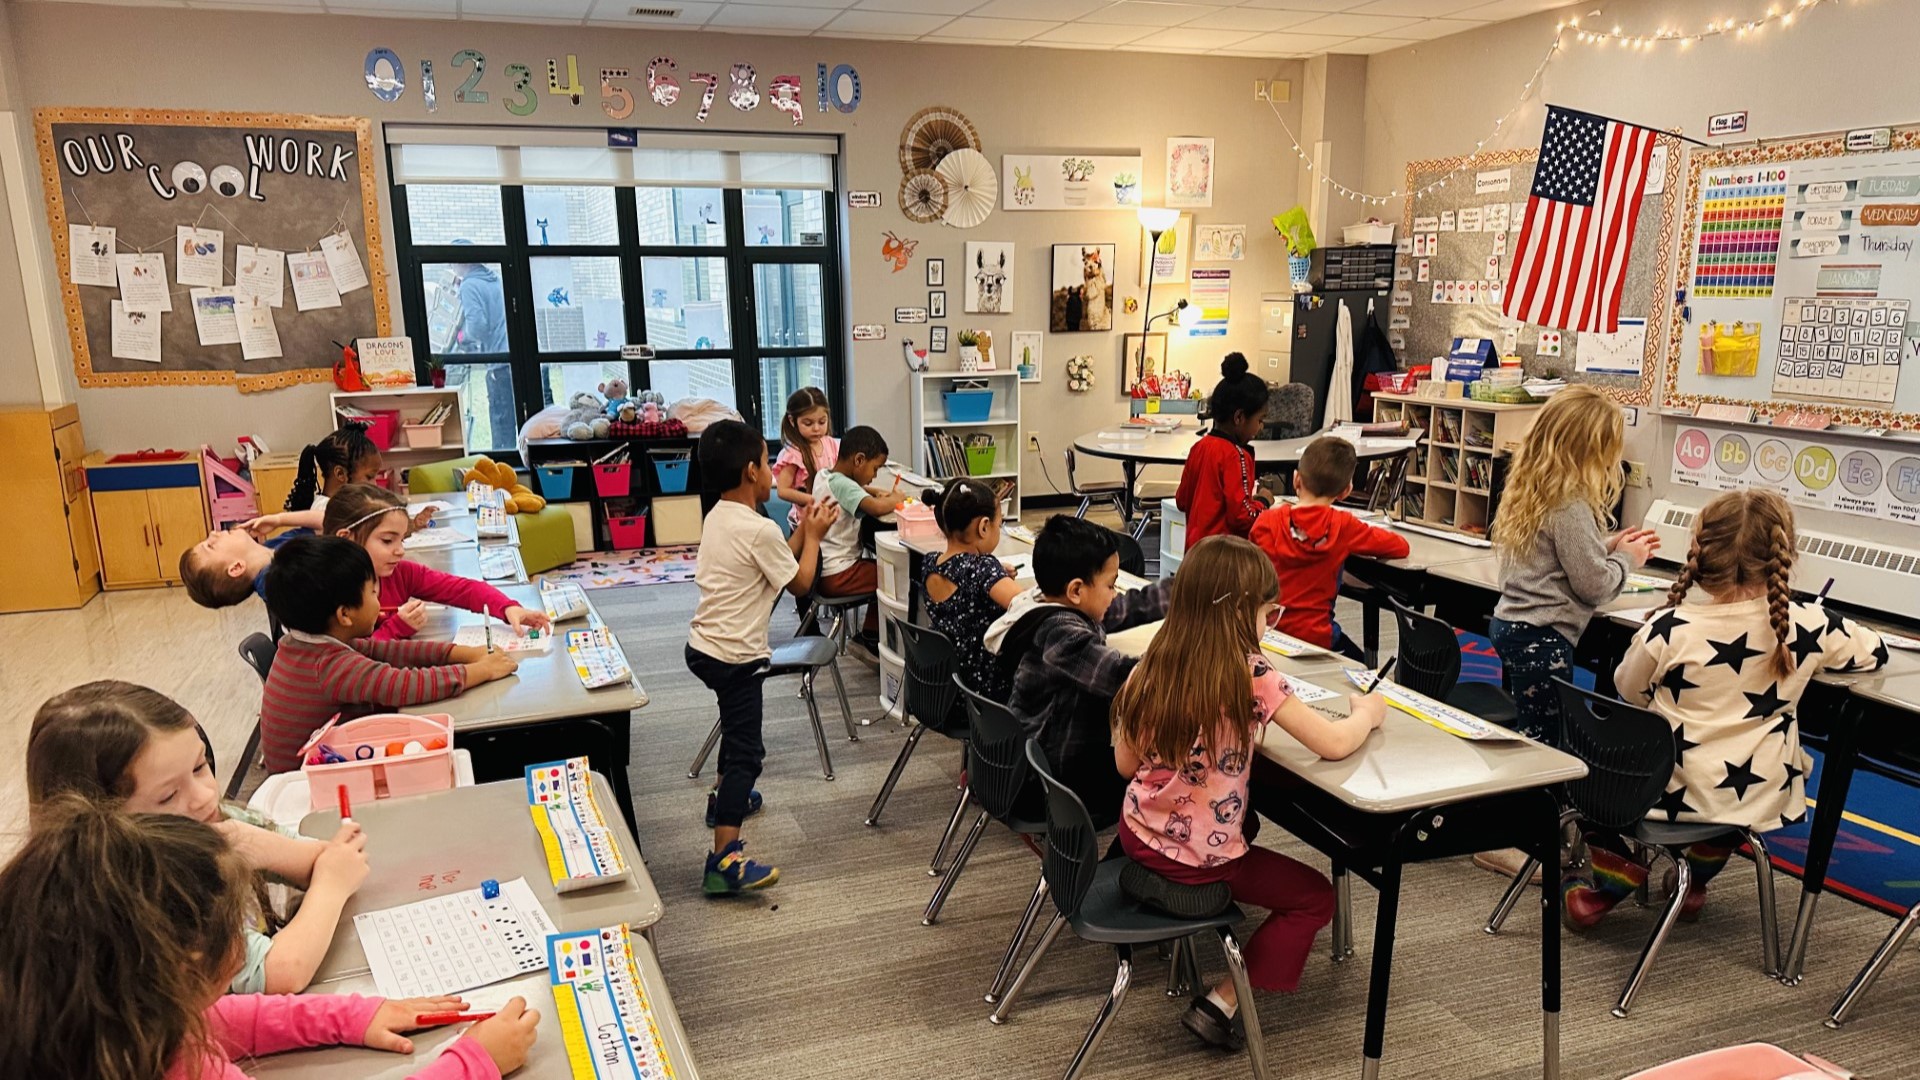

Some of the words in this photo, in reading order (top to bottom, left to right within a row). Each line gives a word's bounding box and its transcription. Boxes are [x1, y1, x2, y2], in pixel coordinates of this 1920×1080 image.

[364, 47, 405, 101] 0
[421, 60, 438, 113] 1
[451, 49, 489, 103] 2
[502, 63, 538, 116] 3
[546, 54, 585, 95] 4
[600, 68, 635, 120] 5
[647, 55, 681, 107] 6
[689, 71, 719, 123] 7
[728, 61, 761, 111] 8
[769, 74, 803, 126] 9
[817, 63, 861, 113] 10
[62, 132, 145, 176] OUR
[245, 134, 355, 182] WORK
[1708, 174, 1753, 187] Numbers
[1757, 170, 1786, 183] 1-100
[1869, 181, 1910, 192] TUESDAY
[1864, 208, 1919, 221] WEDNESDAY
[1861, 234, 1914, 262] Thursday
[1806, 309, 1810, 317] 1
[1823, 310, 1829, 319] 2
[1839, 312, 1844, 321] 3
[1856, 314, 1862, 323] 4
[1875, 312, 1881, 321] 5
[1893, 313, 1900, 323] 6
[366, 342, 404, 350] DRAGONS
[1786, 329, 1791, 337] 7
[1803, 330, 1808, 338] 8
[1833, 329, 1843, 338] 10
[1854, 332, 1860, 341] 11
[1889, 333, 1898, 343] 13
[1783, 344, 1791, 353] 14
[1800, 347, 1807, 356] 15
[1816, 348, 1824, 357] 16
[1832, 348, 1840, 357] 17
[1850, 351, 1858, 360] 18
[1866, 352, 1874, 361] 19
[1886, 352, 1898, 361] 20
[1781, 364, 1791, 372] 21
[1796, 365, 1806, 373] 22
[1811, 367, 1821, 376] 23
[1830, 364, 1840, 374] 24
[1680, 436, 1705, 459] Aa
[1721, 440, 1746, 464] Bb
[1760, 446, 1788, 472] Cc
[1800, 454, 1831, 480] Dd
[1679, 477, 1698, 486] learning
[1846, 458, 1874, 486] Ee
[598, 1022, 624, 1066] Cotton
